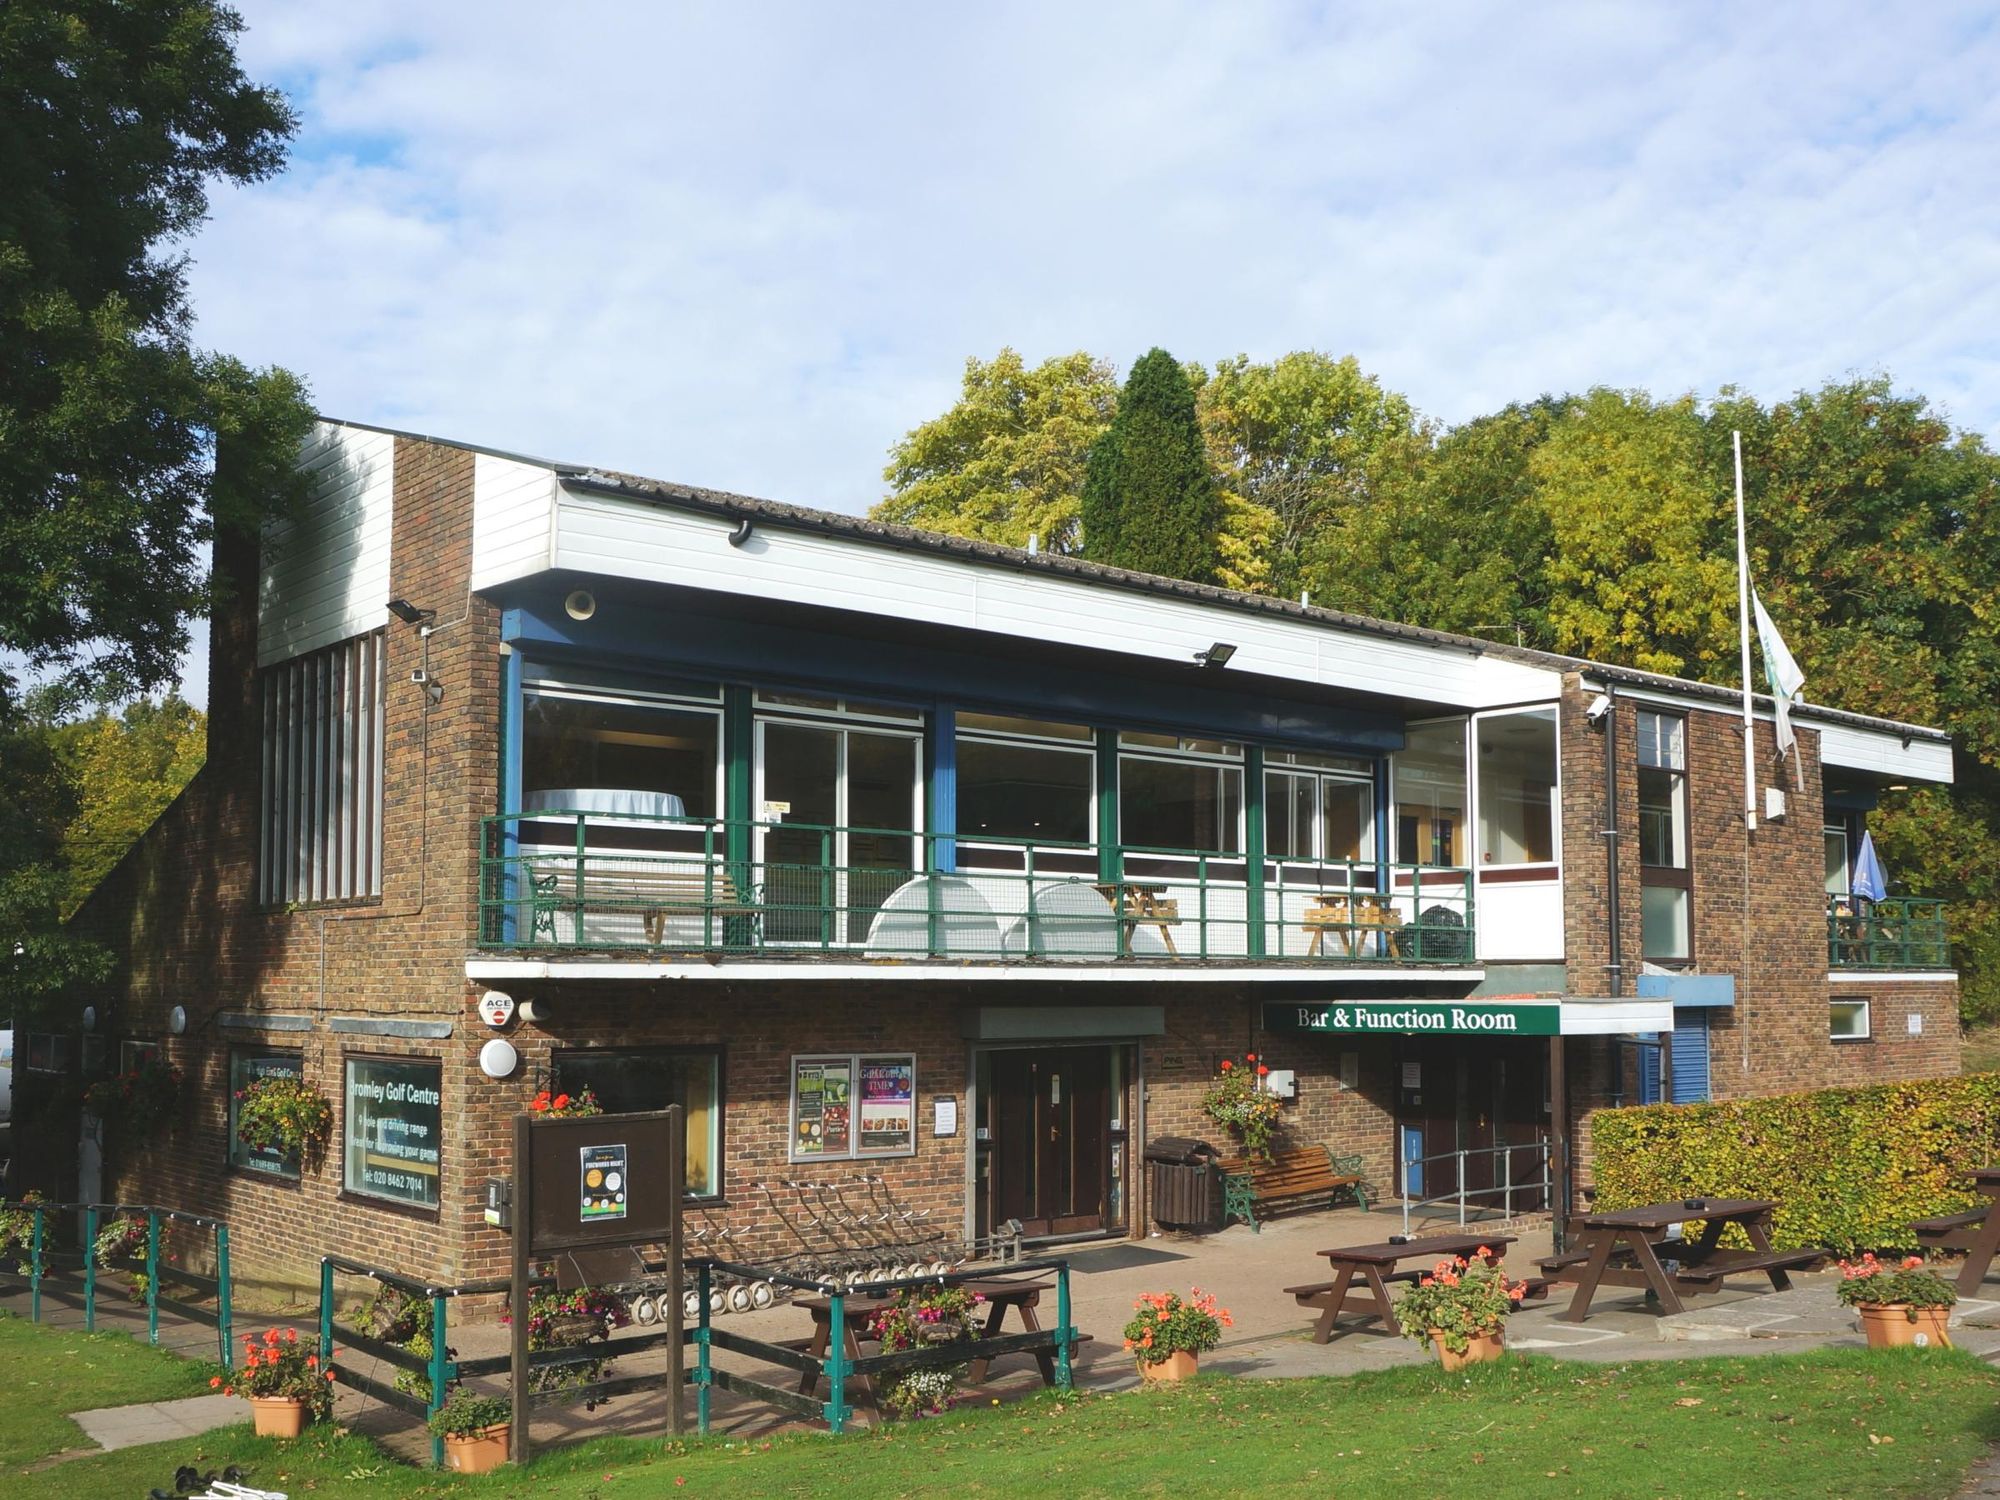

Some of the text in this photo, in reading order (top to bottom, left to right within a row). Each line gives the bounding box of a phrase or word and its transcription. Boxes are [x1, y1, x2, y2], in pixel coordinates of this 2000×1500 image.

[1297, 1008, 1517, 1031] Bar & Function Room
[350, 1080, 439, 1105] Bromley Golf Centre
[868, 1081, 890, 1091] TIME
[388, 1119, 409, 1136] driving
[410, 1123, 428, 1138] range
[404, 1145, 419, 1158] your
[419, 1148, 438, 1161] game
[362, 1168, 422, 1191] Tel: 020 8462 7014
